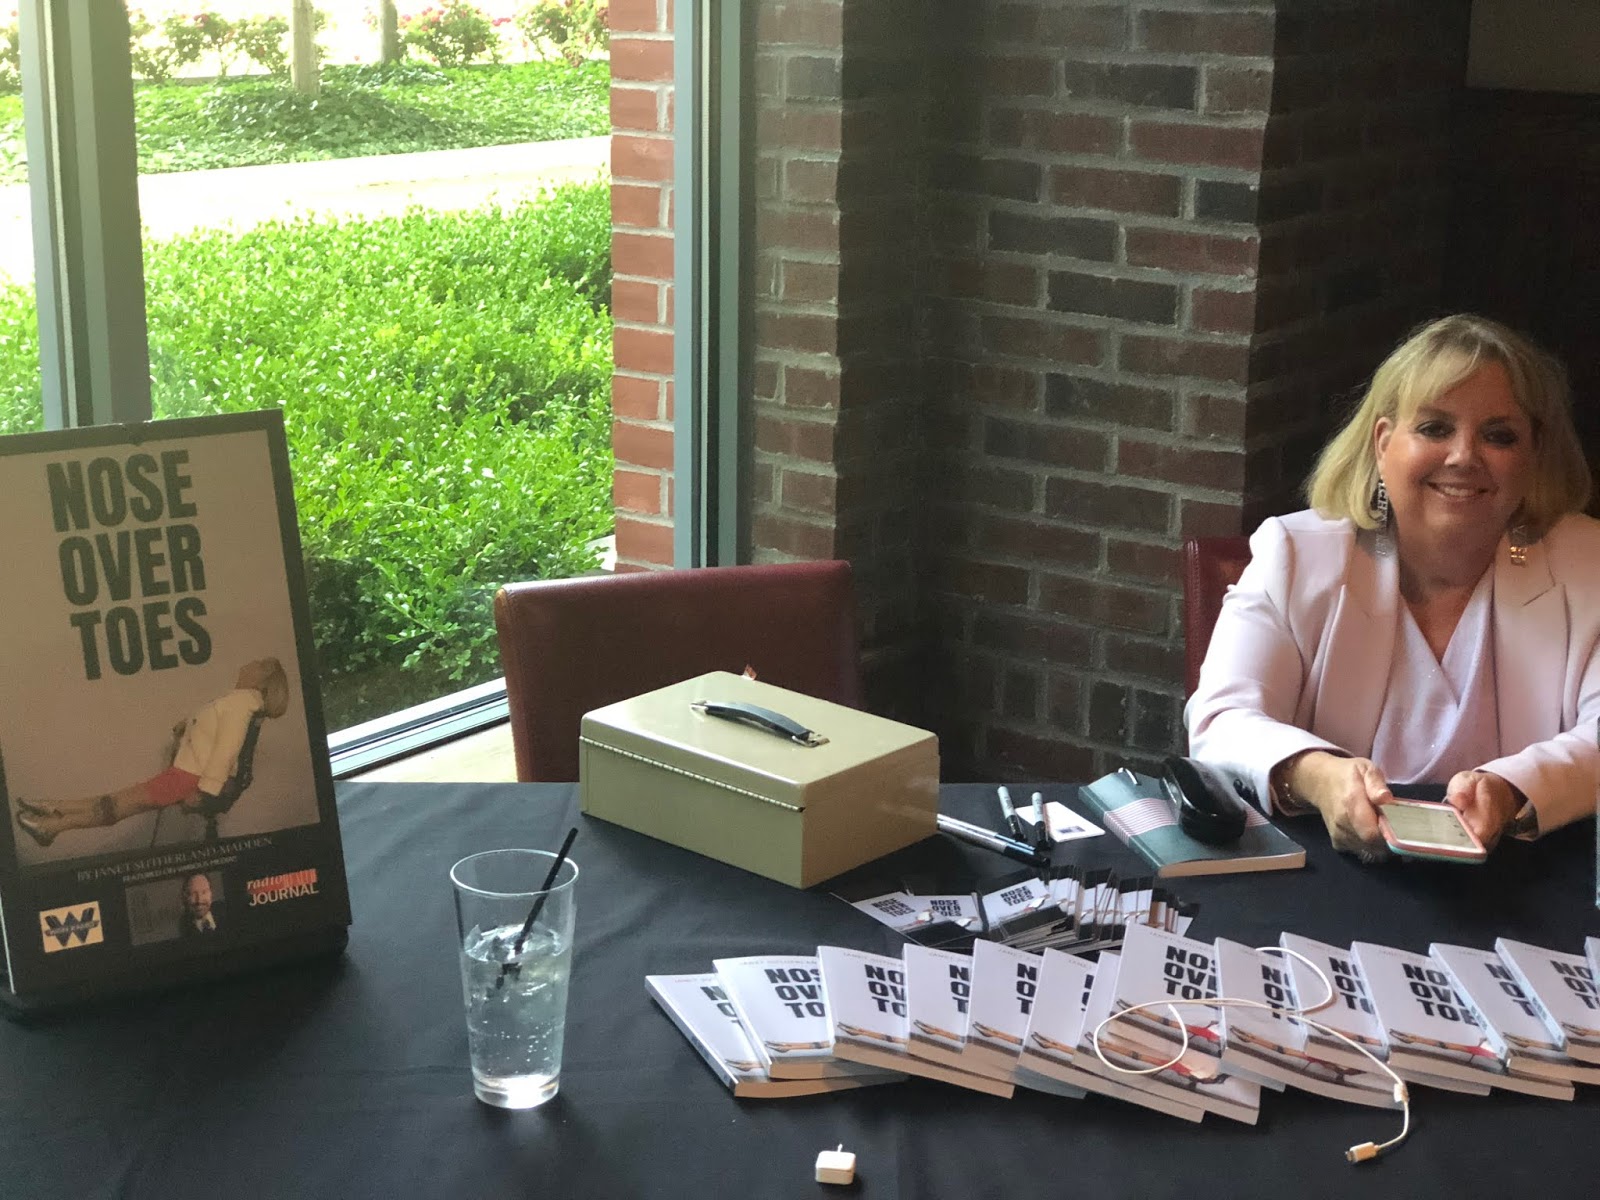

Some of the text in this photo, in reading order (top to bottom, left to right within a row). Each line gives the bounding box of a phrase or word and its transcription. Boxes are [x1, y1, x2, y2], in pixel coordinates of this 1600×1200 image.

[47, 450, 197, 532] NOSE
[58, 524, 206, 606] OVER
[70, 597, 212, 681] TOES
[249, 883, 319, 907] JOURNAL
[1000, 885, 1027, 899] NOSE
[1003, 890, 1032, 902] OVER
[1166, 945, 1216, 970] NO
[764, 968, 821, 983] NOS
[864, 964, 904, 986] NO
[1164, 962, 1218, 991] OV
[1402, 963, 1448, 986] NO
[1550, 960, 1593, 980] NO
[775, 985, 822, 1001] OV
[868, 981, 906, 1002] OV
[1163, 977, 1219, 1006] TO
[1409, 982, 1465, 1007] OV
[784, 1002, 826, 1018] TO
[872, 996, 907, 1018] TO
[1416, 998, 1479, 1027] TOE
